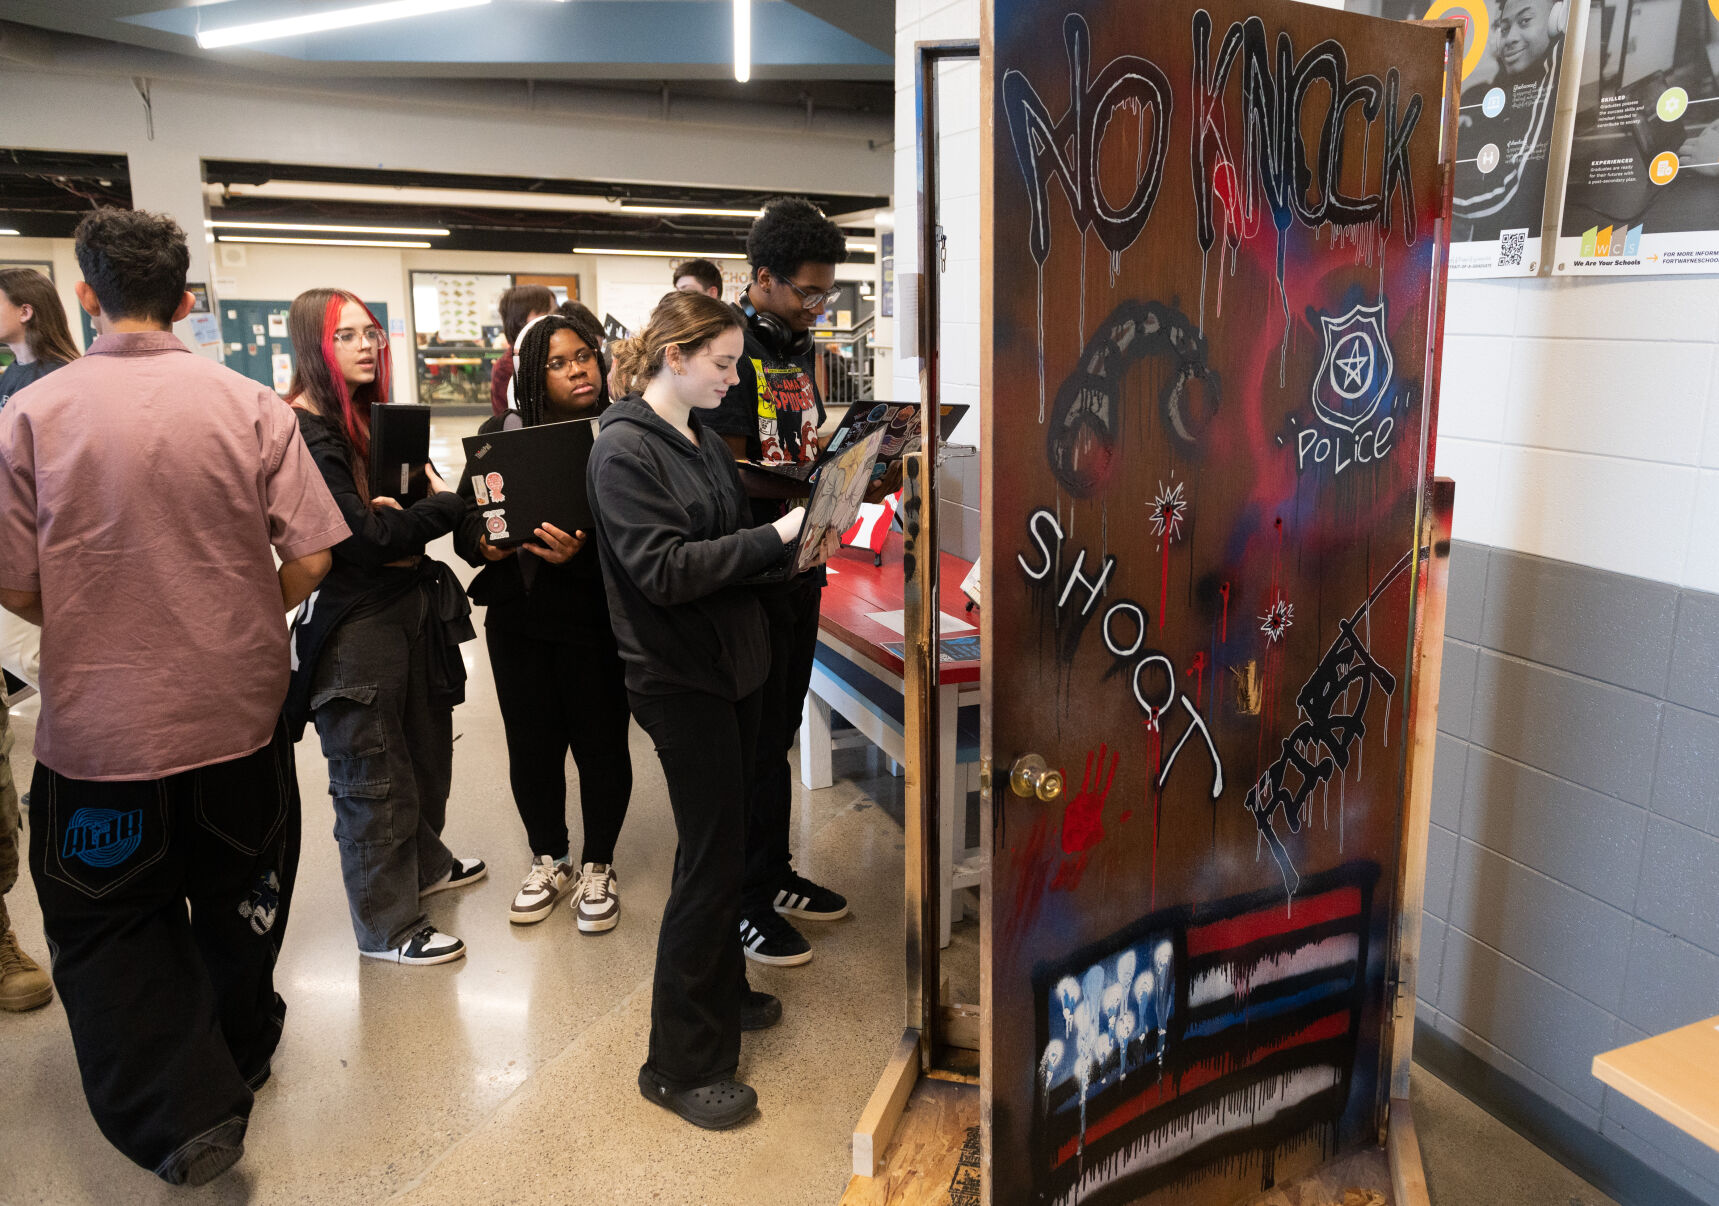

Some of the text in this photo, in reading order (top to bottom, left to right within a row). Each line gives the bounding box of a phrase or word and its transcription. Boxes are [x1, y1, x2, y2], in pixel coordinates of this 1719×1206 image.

[1601, 95, 1626, 103] SKILLED
[1003, 12, 1173, 268] NO
[1591, 158, 1634, 166] EXPERIENCED
[1583, 243, 1636, 255] FWCS
[1017, 510, 1224, 798] SHOOT
